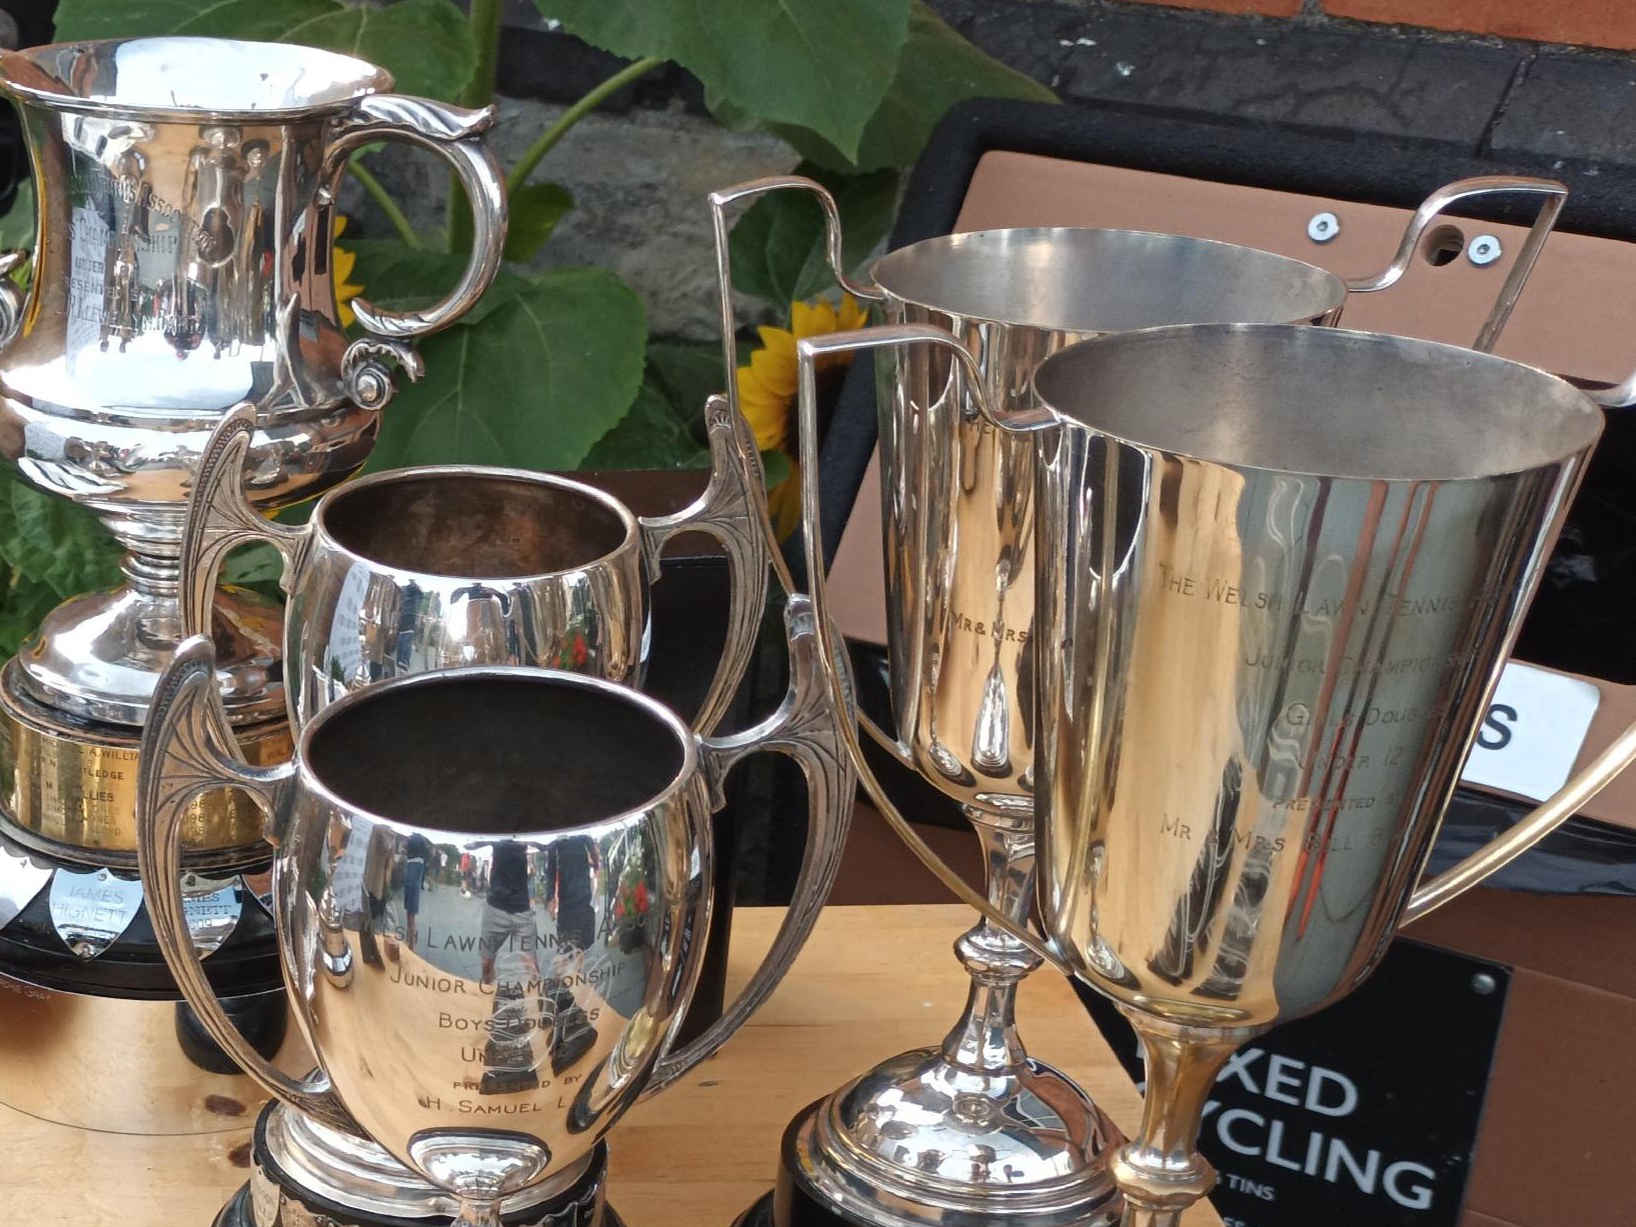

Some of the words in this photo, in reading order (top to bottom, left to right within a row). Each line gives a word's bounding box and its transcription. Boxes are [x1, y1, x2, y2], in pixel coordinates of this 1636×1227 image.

[1205, 578, 1281, 611] WELSH
[67, 884, 125, 905] JAMES
[51, 900, 129, 925] HIGNETT
[427, 924, 494, 952] LAWN
[390, 968, 466, 994] JUNIOR
[478, 961, 626, 996] CHAMPIONSHIP
[437, 1011, 495, 1032] BOYS
[563, 1074, 583, 1086] BY
[458, 1098, 542, 1115] SAMUEL
[1227, 1172, 1275, 1202] TINS
